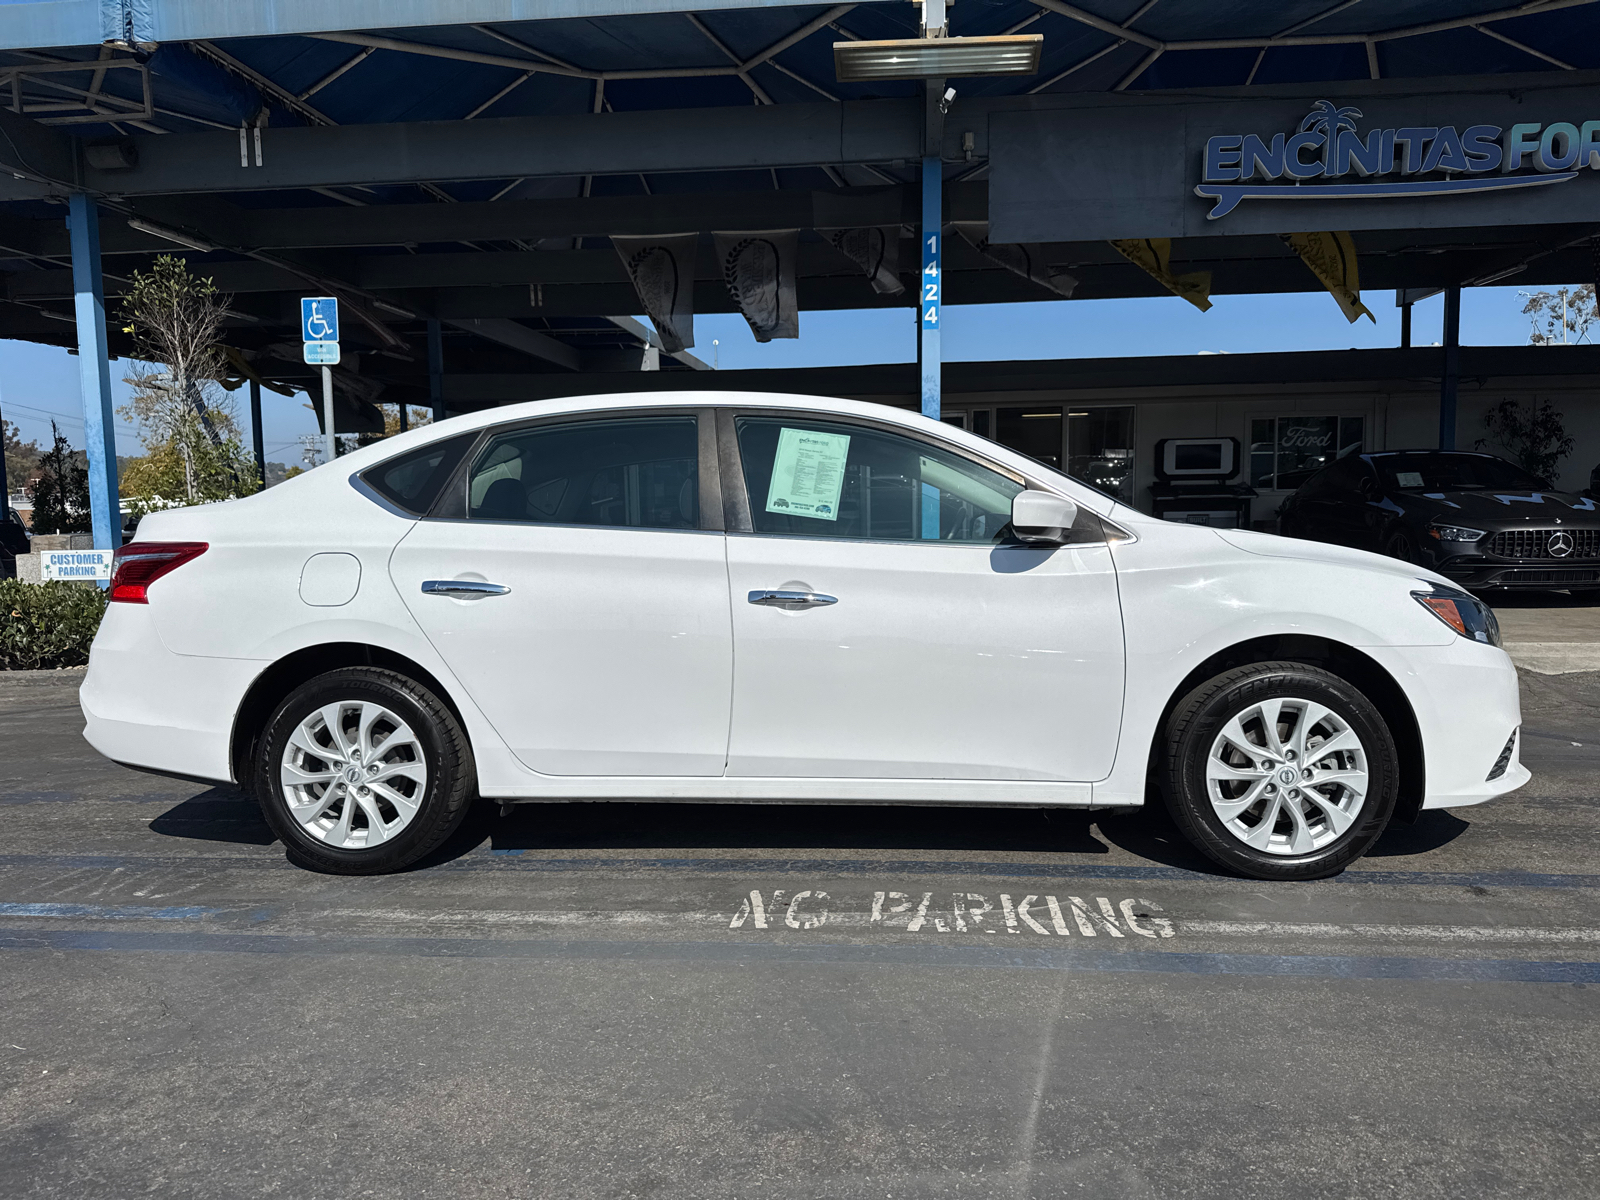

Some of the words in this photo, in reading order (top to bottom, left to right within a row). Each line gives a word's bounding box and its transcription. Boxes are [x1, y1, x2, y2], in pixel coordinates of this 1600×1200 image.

[1203, 112, 1503, 183] ENCINITAS
[924, 235, 938, 324] 1424
[1281, 426, 1333, 448] Ford
[50, 554, 103, 565] CUSTOMER
[58, 566, 96, 576] PARKING
[341, 680, 406, 702] TOURING
[871, 891, 1175, 938] PARKING
